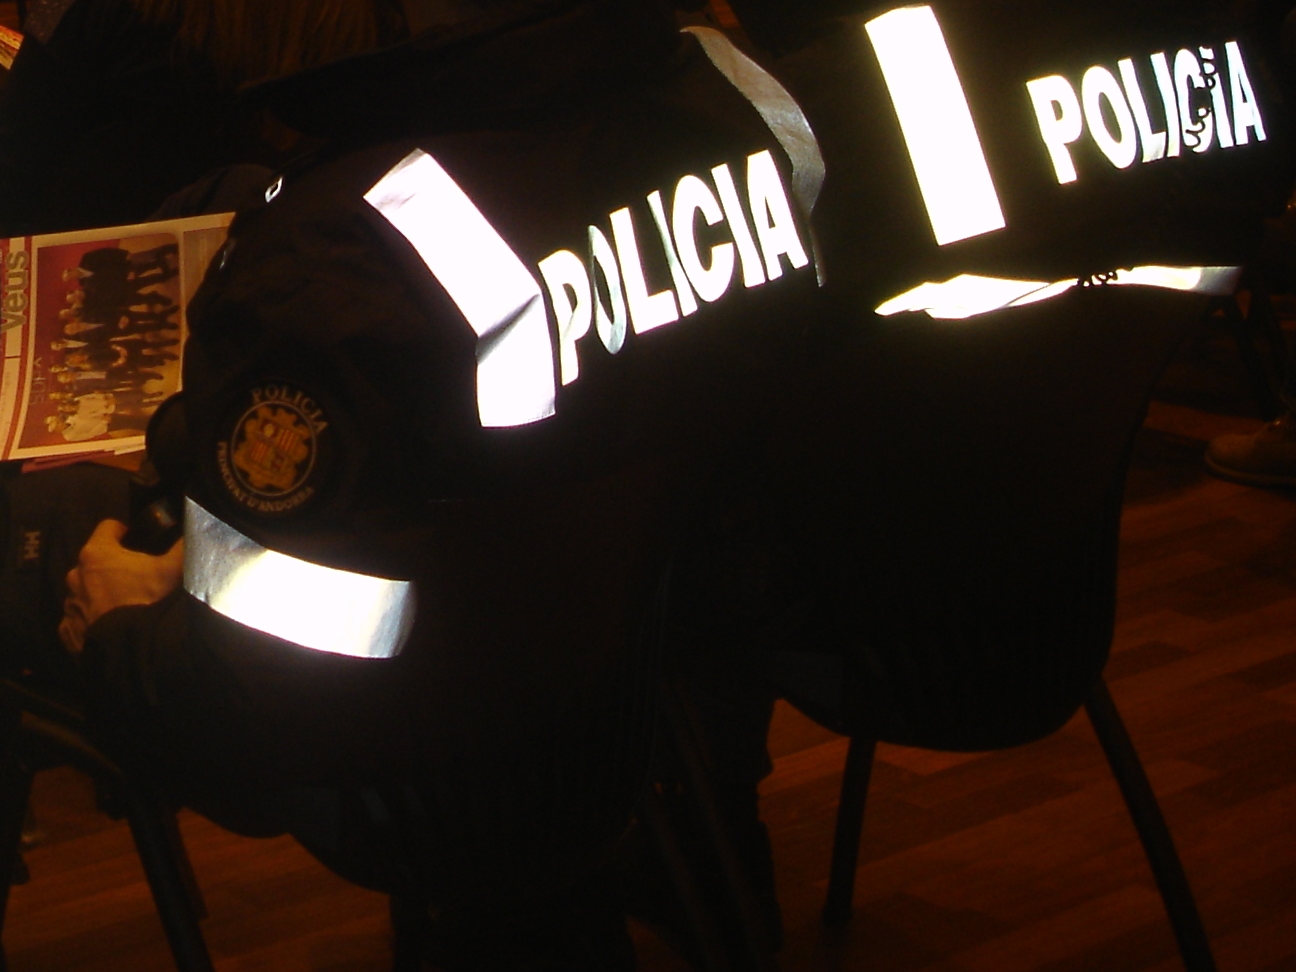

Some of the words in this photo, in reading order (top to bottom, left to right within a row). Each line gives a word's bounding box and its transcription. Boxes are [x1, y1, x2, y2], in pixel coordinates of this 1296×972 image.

[1026, 41, 1266, 184] POLICIA
[0, 249, 29, 331] Veus
[537, 150, 810, 386] POLICIA
[251, 384, 329, 436] POLICIA
